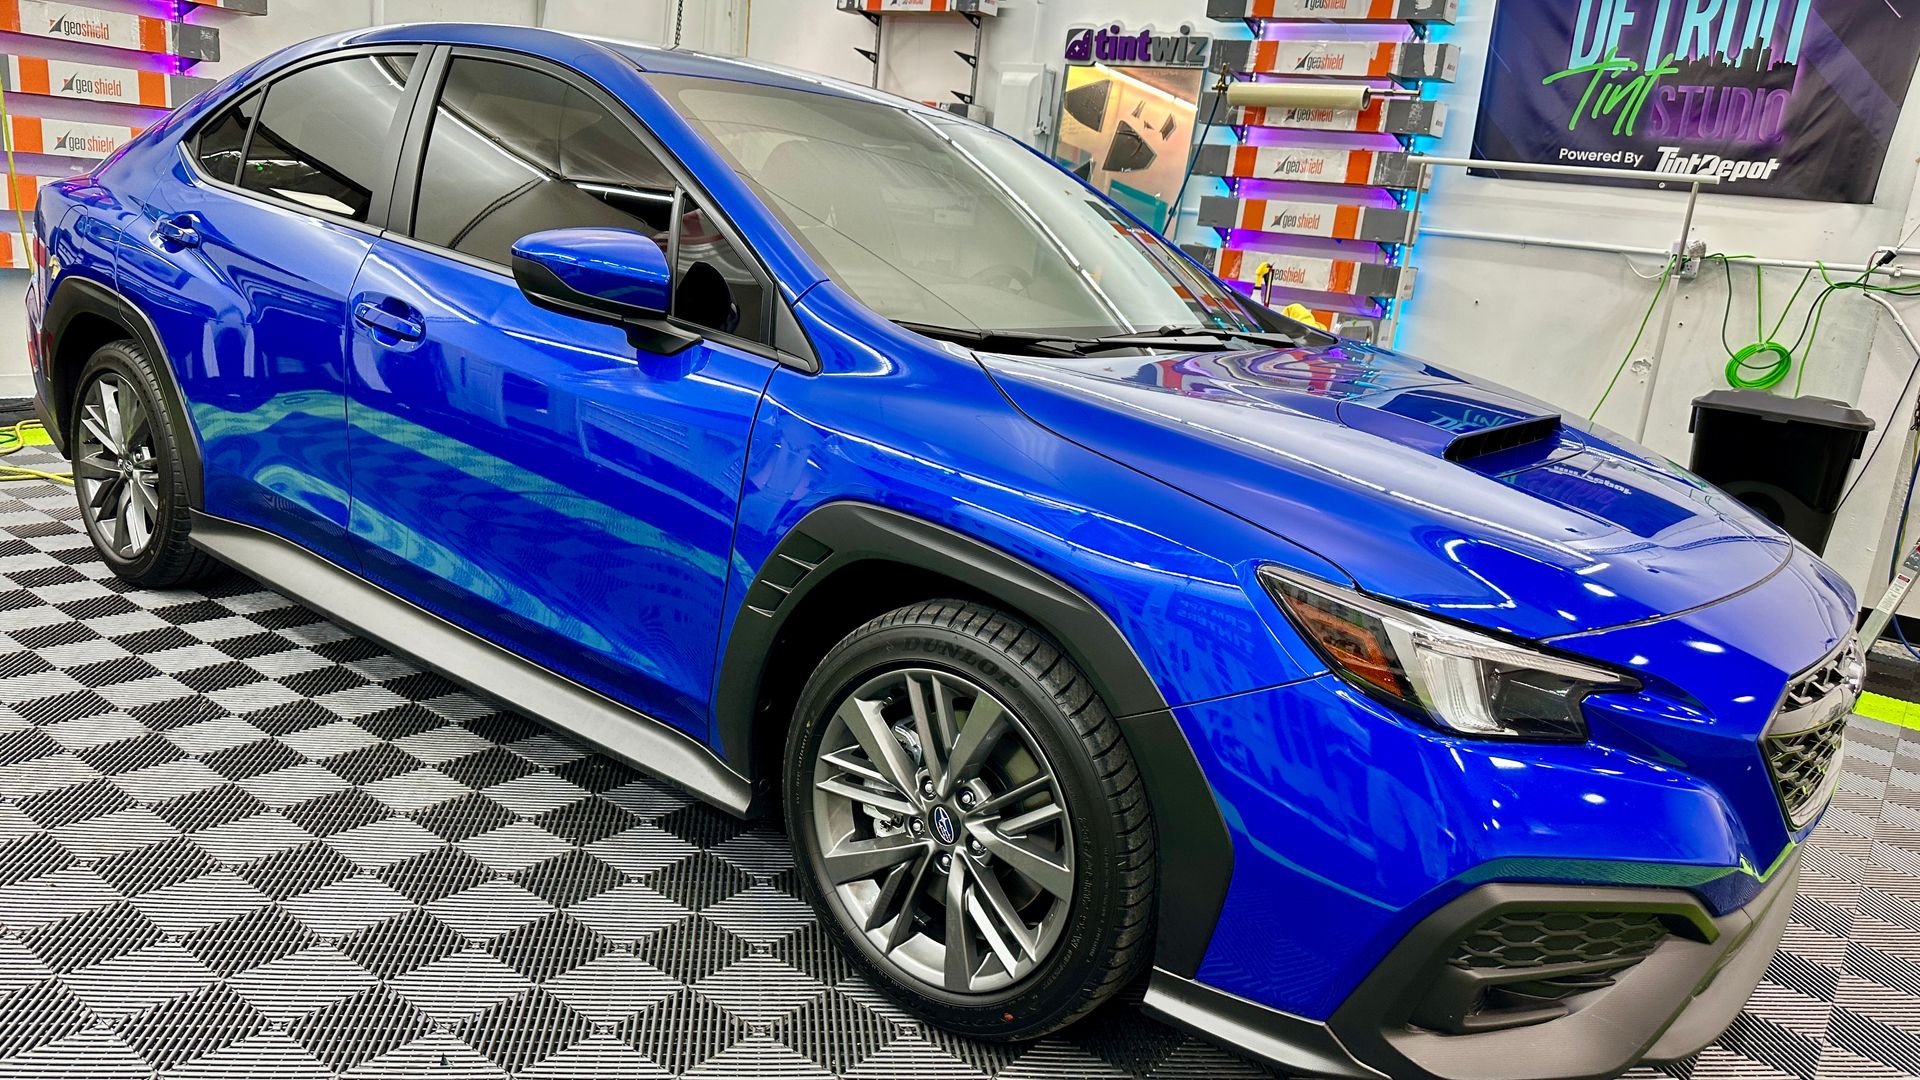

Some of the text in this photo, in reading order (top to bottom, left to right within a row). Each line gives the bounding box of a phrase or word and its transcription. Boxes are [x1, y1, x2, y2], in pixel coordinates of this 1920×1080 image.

[64, 20, 109, 40] geoshield
[1095, 24, 1208, 62] tintwiz
[1567, 0, 1811, 71] DETROIT
[1542, 47, 1679, 136] Tint
[1650, 84, 1792, 143] STUDIO
[1559, 148, 1644, 168] Powered By
[1274, 267, 1305, 284] eoshield
[902, 637, 1020, 689] DUNLOP
